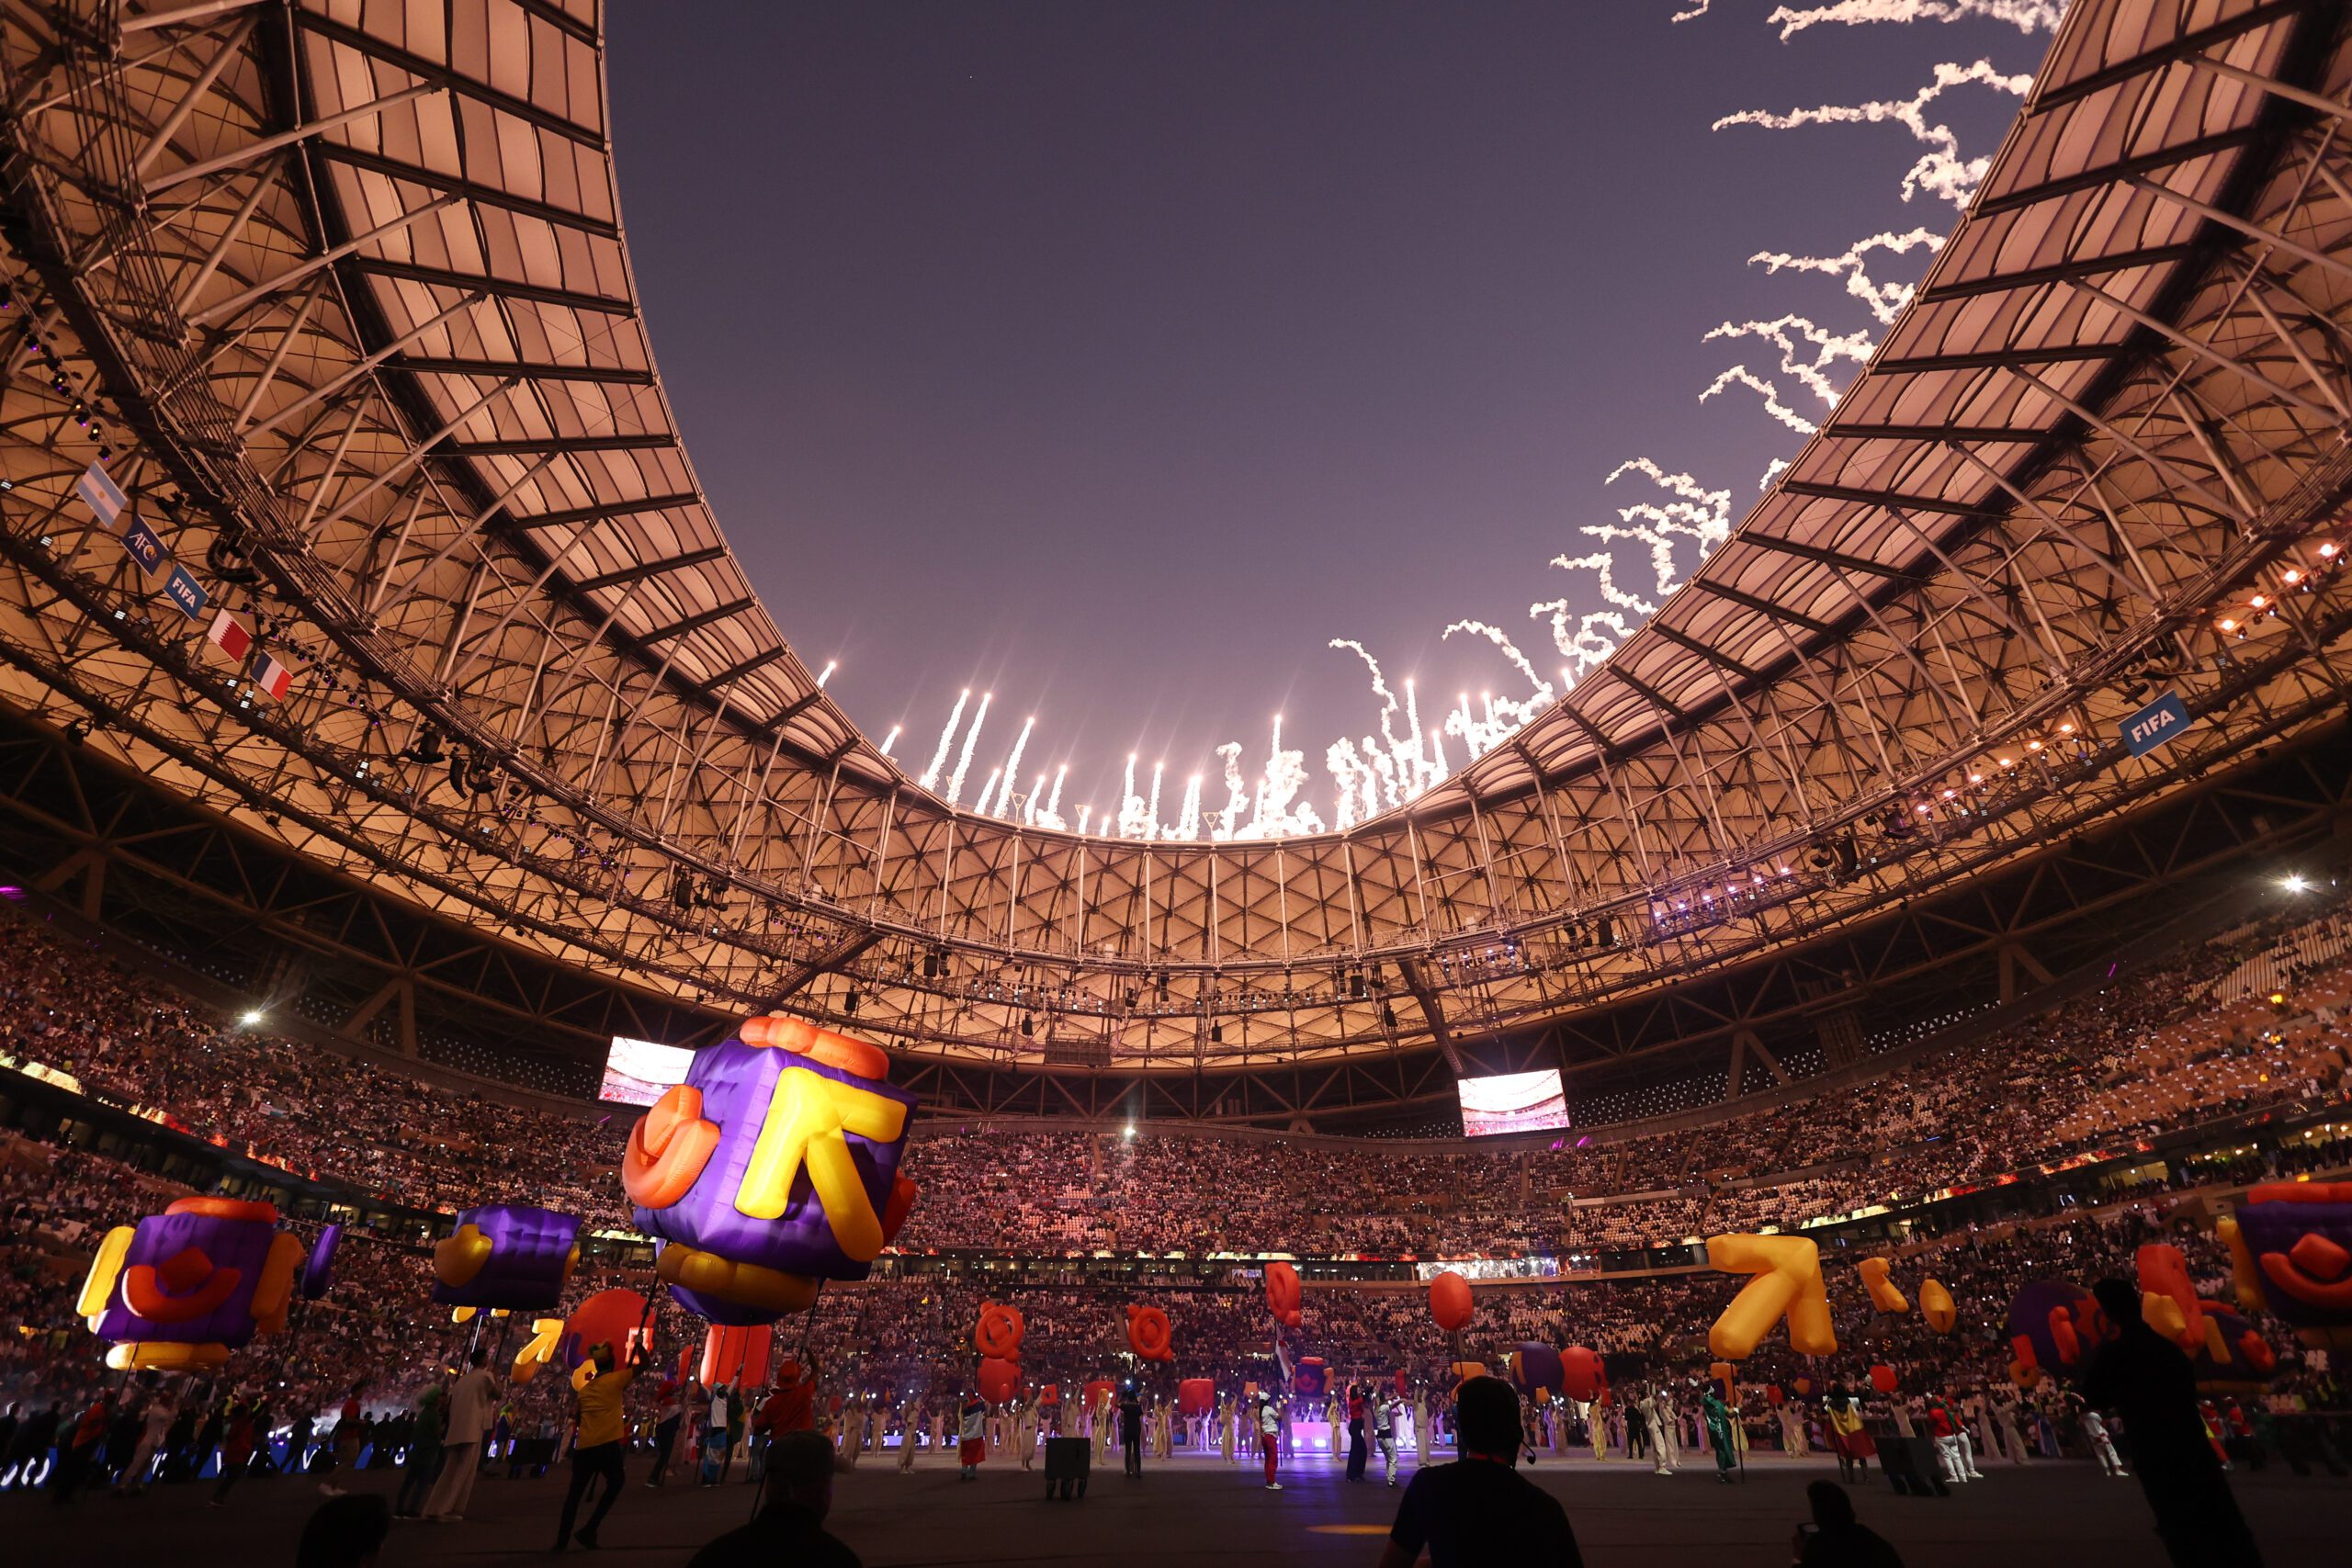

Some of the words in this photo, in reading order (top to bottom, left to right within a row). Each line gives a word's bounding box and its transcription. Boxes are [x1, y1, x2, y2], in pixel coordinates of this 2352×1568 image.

[129, 532, 156, 561] AFC
[172, 577, 197, 608] FIFA
[2131, 709, 2176, 742] FIFA
